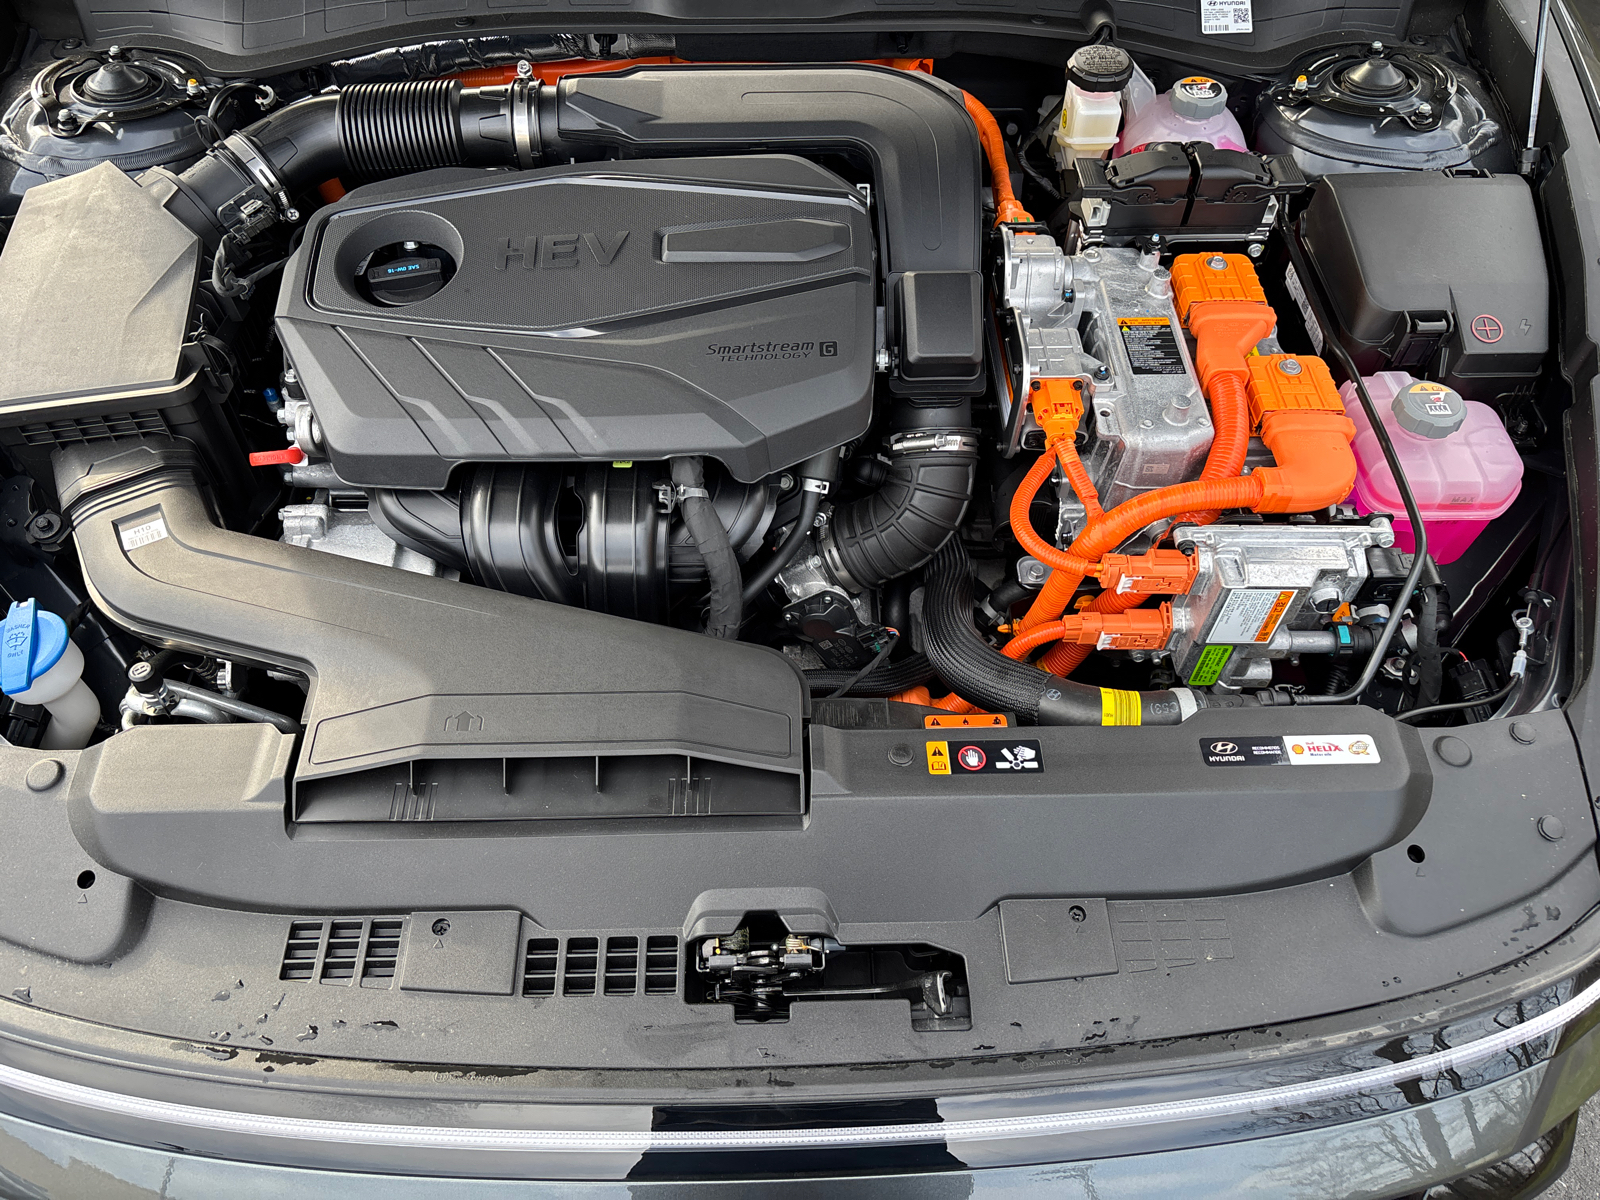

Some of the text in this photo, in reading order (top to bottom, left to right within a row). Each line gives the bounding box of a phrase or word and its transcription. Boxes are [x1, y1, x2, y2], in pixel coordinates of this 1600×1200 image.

[495, 230, 630, 270] HEV
[706, 341, 837, 356] Smartstream G
[720, 352, 811, 362] TECHNOLOGY
